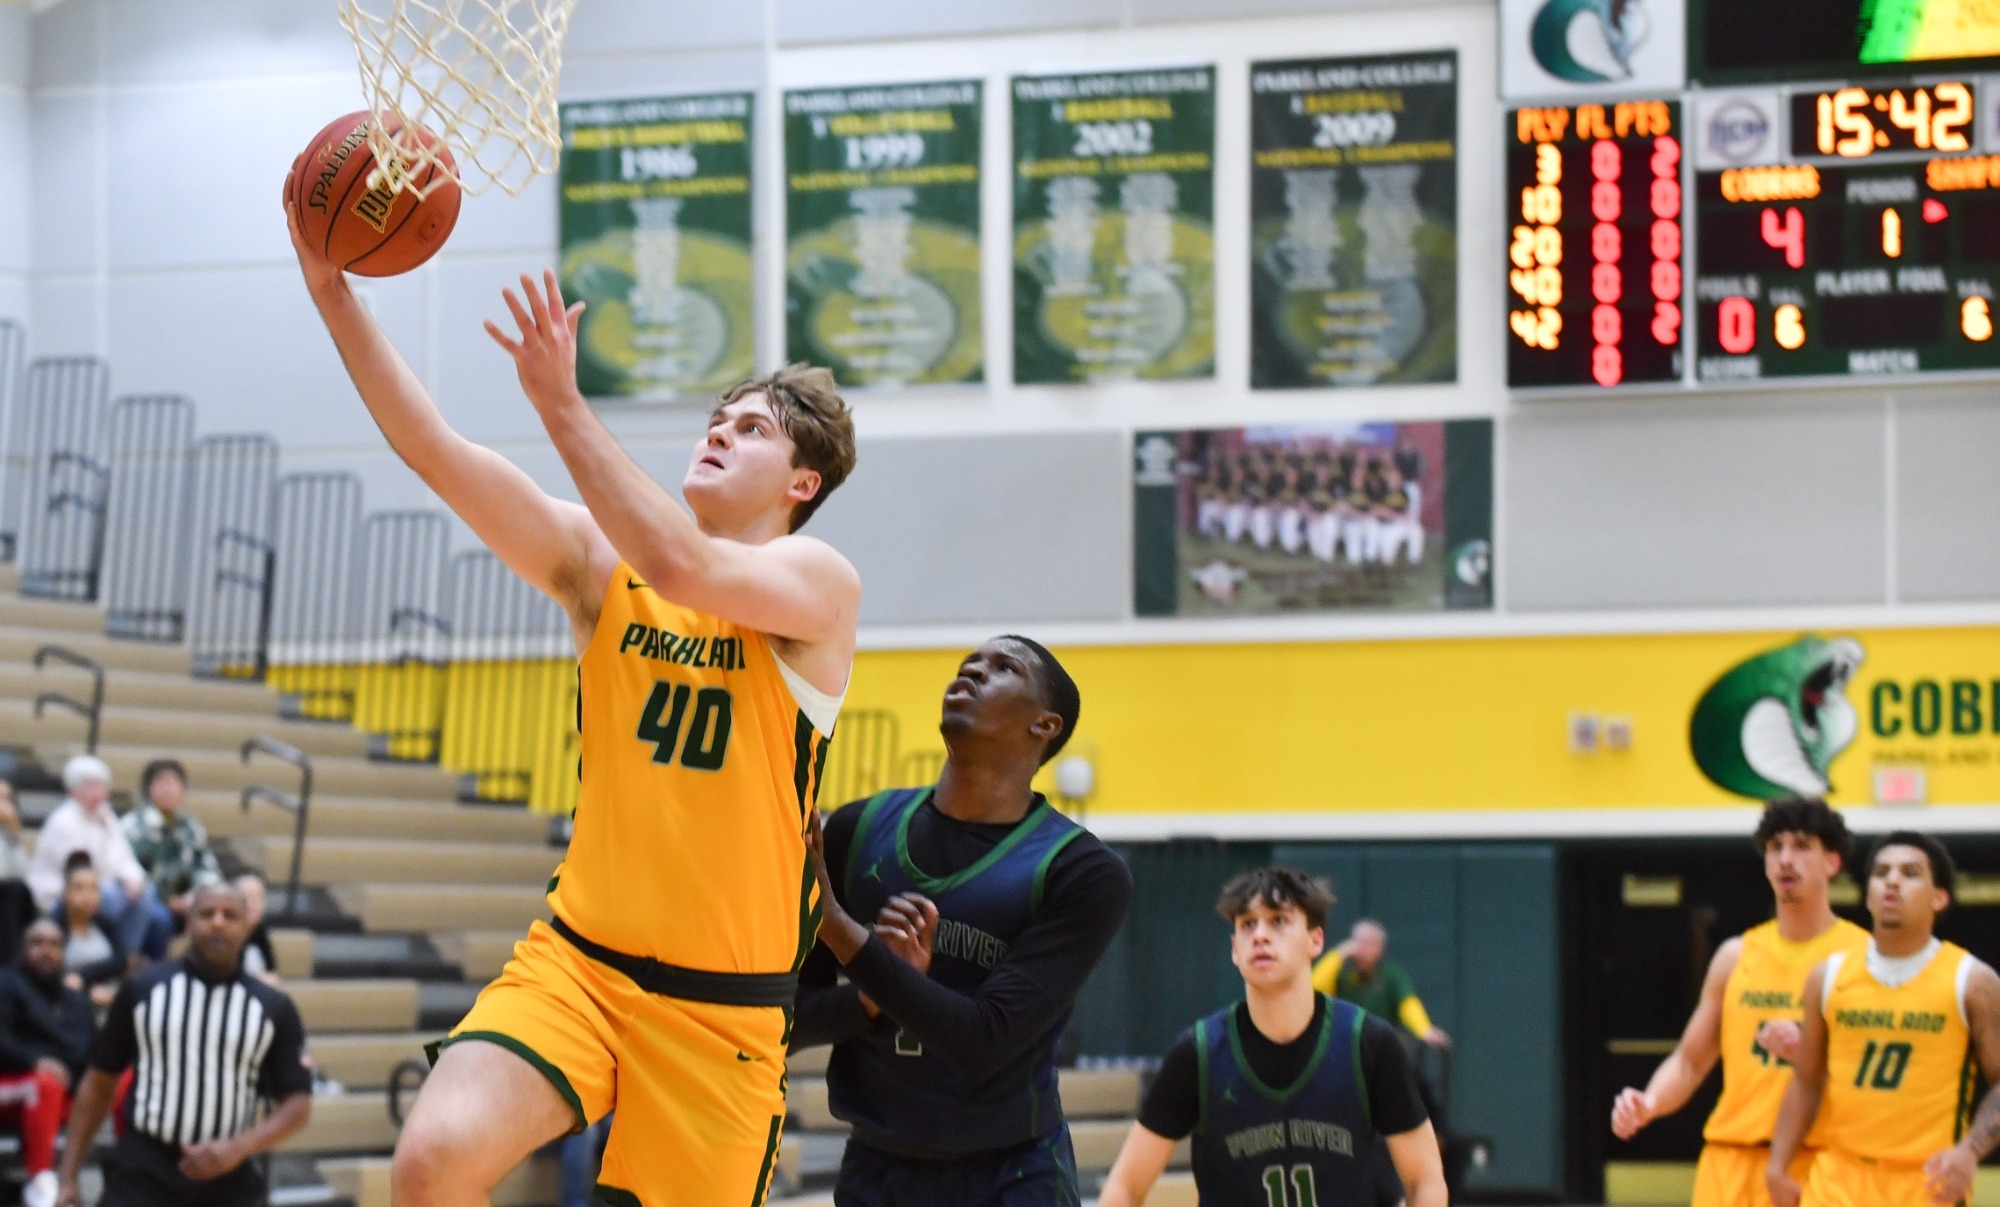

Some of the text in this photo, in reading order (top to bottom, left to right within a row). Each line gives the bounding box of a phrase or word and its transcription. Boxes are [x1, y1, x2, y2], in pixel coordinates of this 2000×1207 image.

[1074, 119, 1152, 156] 2002
[1314, 110, 1395, 148] 2009
[1517, 101, 1670, 143] PLY FL PTS
[1817, 82, 1972, 158] 15:42
[846, 132, 924, 169] 1999
[1536, 135, 1682, 184] 3 0 2
[1522, 178, 1682, 225] 10 0 0
[1510, 219, 1682, 268] 20 0 0
[1761, 207, 1804, 269] 4
[1882, 208, 1901, 258] 1
[1510, 260, 1682, 307] 40 0 0
[1815, 271, 1891, 297] PLAYER
[1896, 266, 1947, 292] FOUL
[1510, 301, 1682, 349] 42 0 2
[1719, 296, 1755, 353] 0
[1774, 304, 1806, 349] 6
[1962, 295, 1993, 341] 6
[1592, 344, 1622, 387] 0
[1849, 350, 1918, 374] MATCH
[636, 678, 734, 772] 40
[1836, 1008, 1947, 1034] PARKLAND
[1853, 1040, 1914, 1090] 10
[1288, 1118, 1354, 1158] RIVER
[1262, 1163, 1318, 1207] 11
